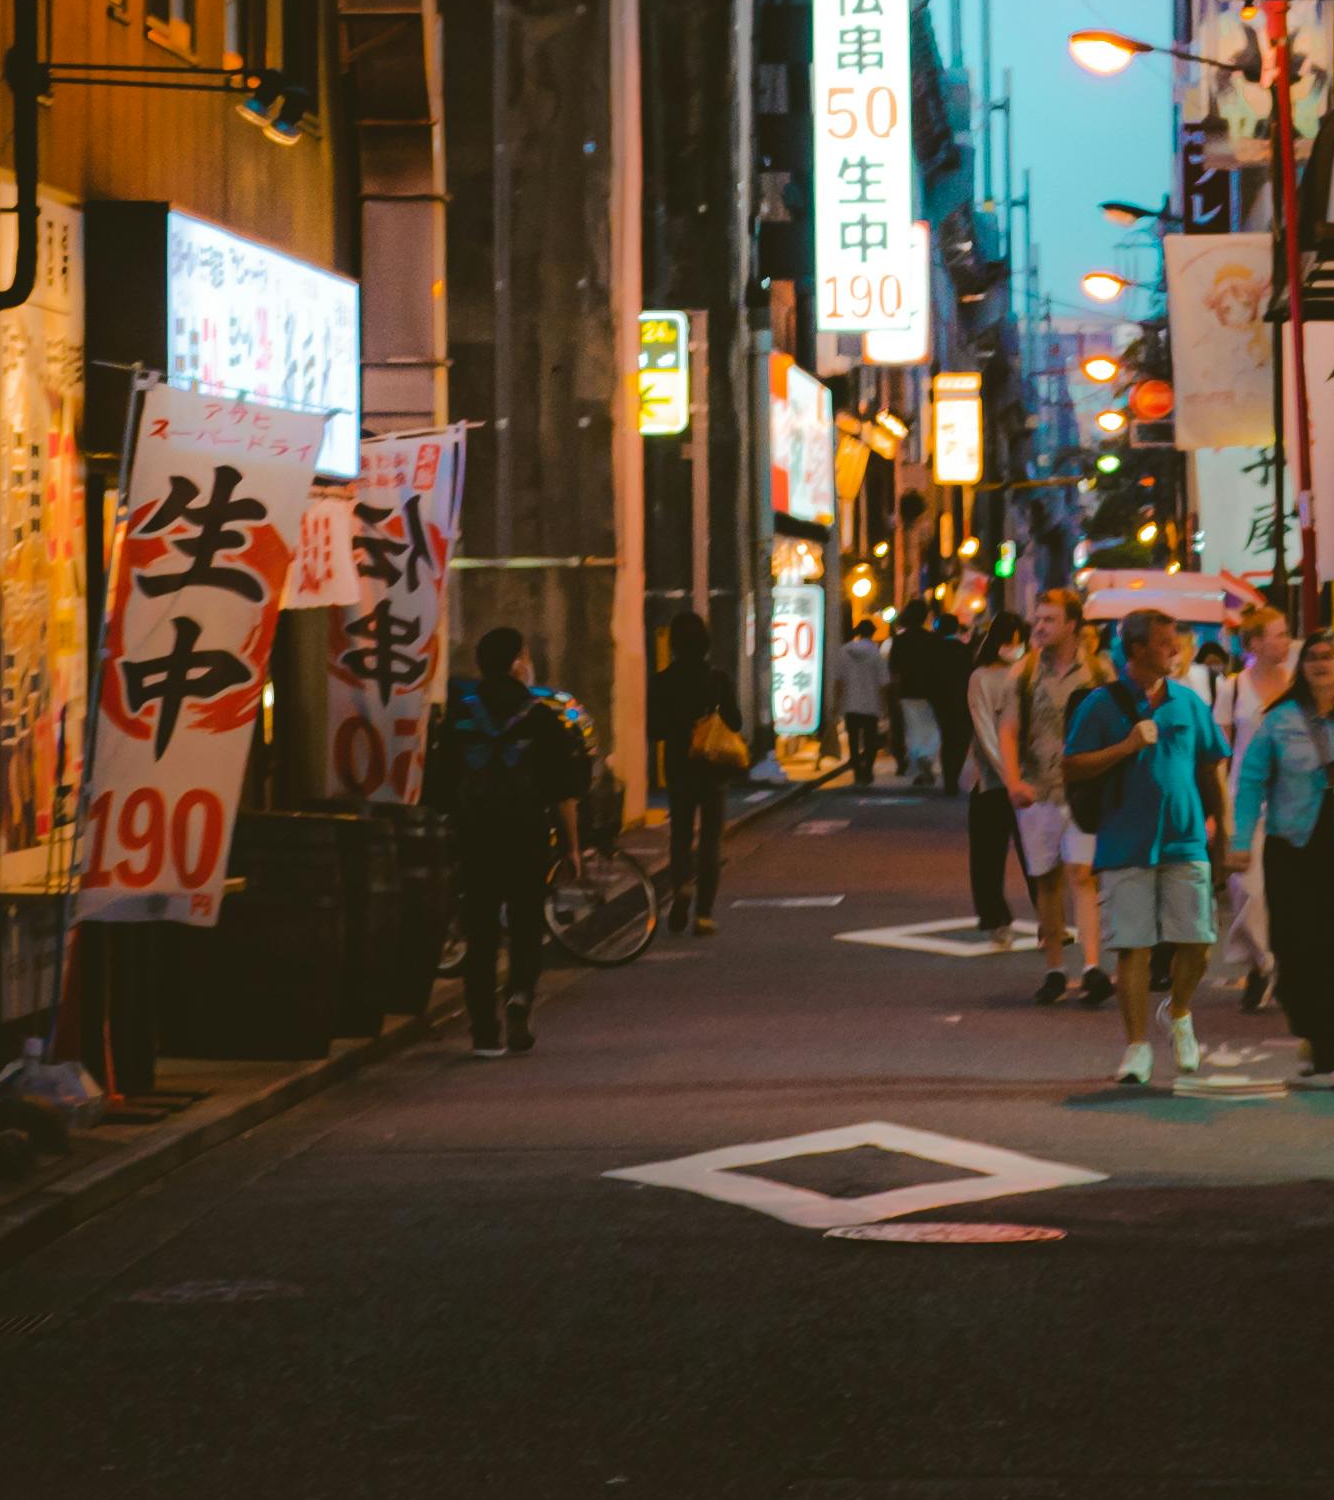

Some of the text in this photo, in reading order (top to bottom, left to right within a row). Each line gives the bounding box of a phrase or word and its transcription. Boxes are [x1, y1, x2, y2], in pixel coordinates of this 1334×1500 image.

[826, 86, 898, 138] 50
[837, 155, 887, 262] 生中
[826, 275, 902, 318] 190
[121, 465, 267, 761] 生中
[81, 787, 224, 889] 190
